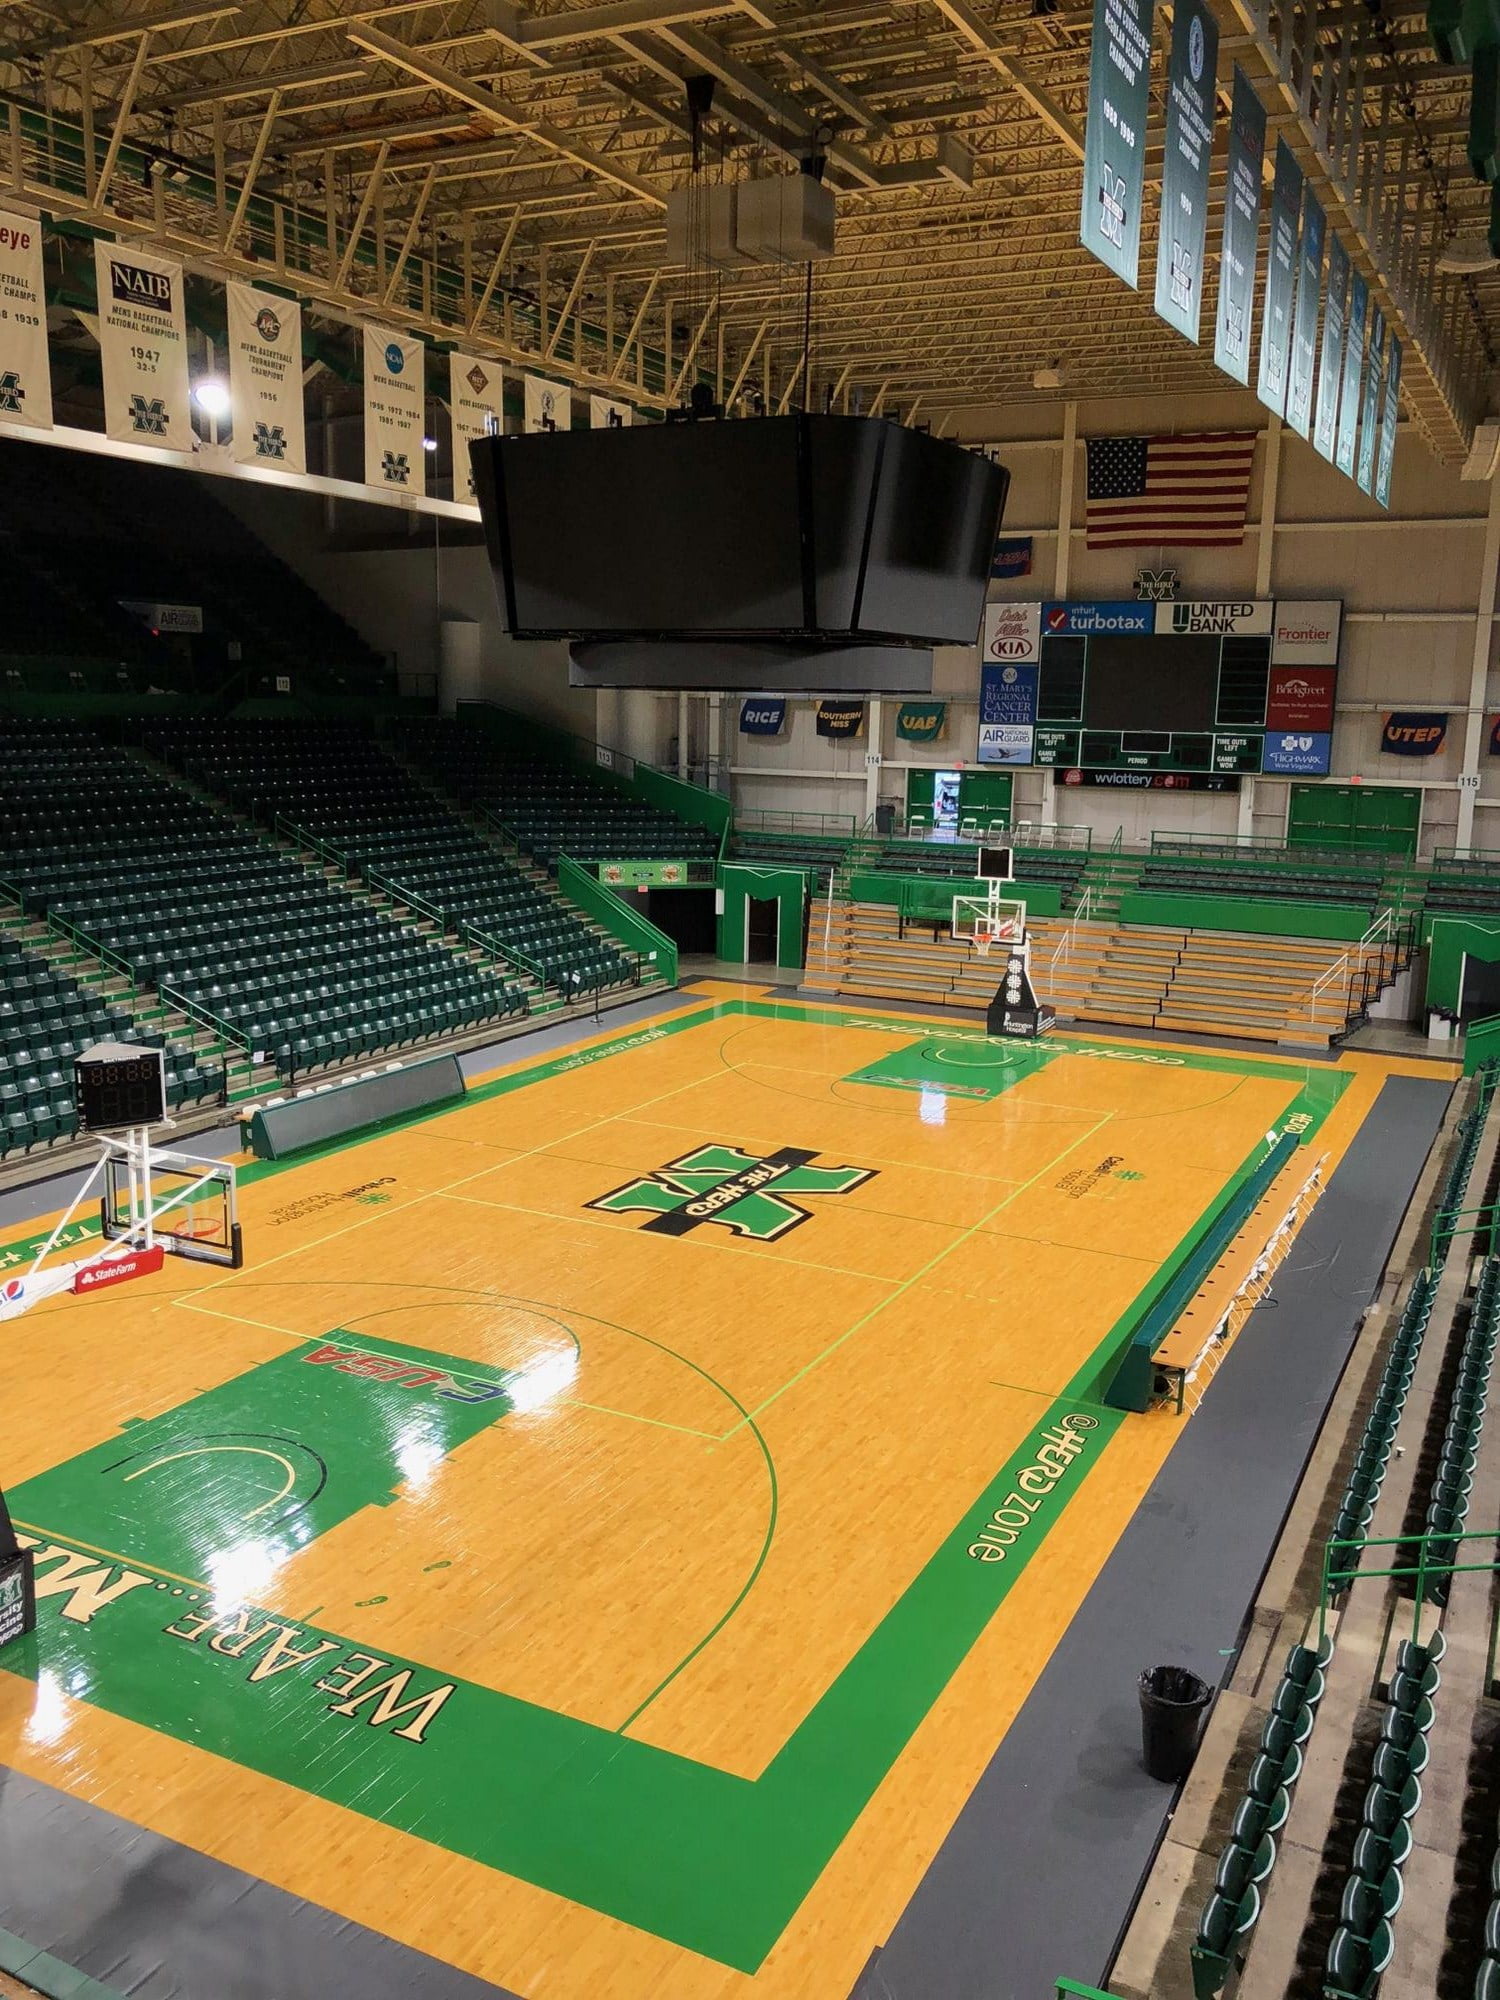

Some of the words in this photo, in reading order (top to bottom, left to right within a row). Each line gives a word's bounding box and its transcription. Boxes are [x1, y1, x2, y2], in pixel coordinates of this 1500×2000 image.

[0, 227, 31, 250] eye
[0, 273, 29, 289] ETBALL
[112, 264, 170, 299] NAIB
[4, 286, 37, 304] CHAMPS
[15, 312, 39, 326] 1939
[112, 305, 132, 318] MENS
[133, 311, 174, 328] BASKETBALL
[106, 315, 140, 332] NATIONAL
[141, 324, 180, 341] CHAMPIONS
[130, 346, 160, 363] 1947
[136, 361, 157, 373] 32-5
[1191, 603, 1254, 618] UNITED
[1070, 613, 1145, 630] turbotax
[1190, 618, 1236, 633] BANK
[1277, 627, 1332, 640] Frontier
[997, 642, 1026, 655] KIA
[984, 691, 1031, 701] REGIONAL
[984, 701, 1031, 711] CANCER
[745, 711, 780, 724] RICE
[819, 711, 862, 720] SOUTHERN
[902, 715, 937, 730] UAB
[983, 711, 1030, 722] CENTER
[829, 719, 850, 728] MISS
[983, 729, 1005, 742] AIR
[1004, 735, 1030, 743] GUARD
[1387, 726, 1442, 742] UTEP
[1231, 738, 1247, 746] OUTS
[867, 756, 880, 765] 114
[1461, 777, 1478, 787] 115
[1075, 1048, 1186, 1066] HERD
[740, 1162, 791, 1188] THE
[685, 1183, 744, 1216] HERD
[314, 1651, 459, 1744] WE
